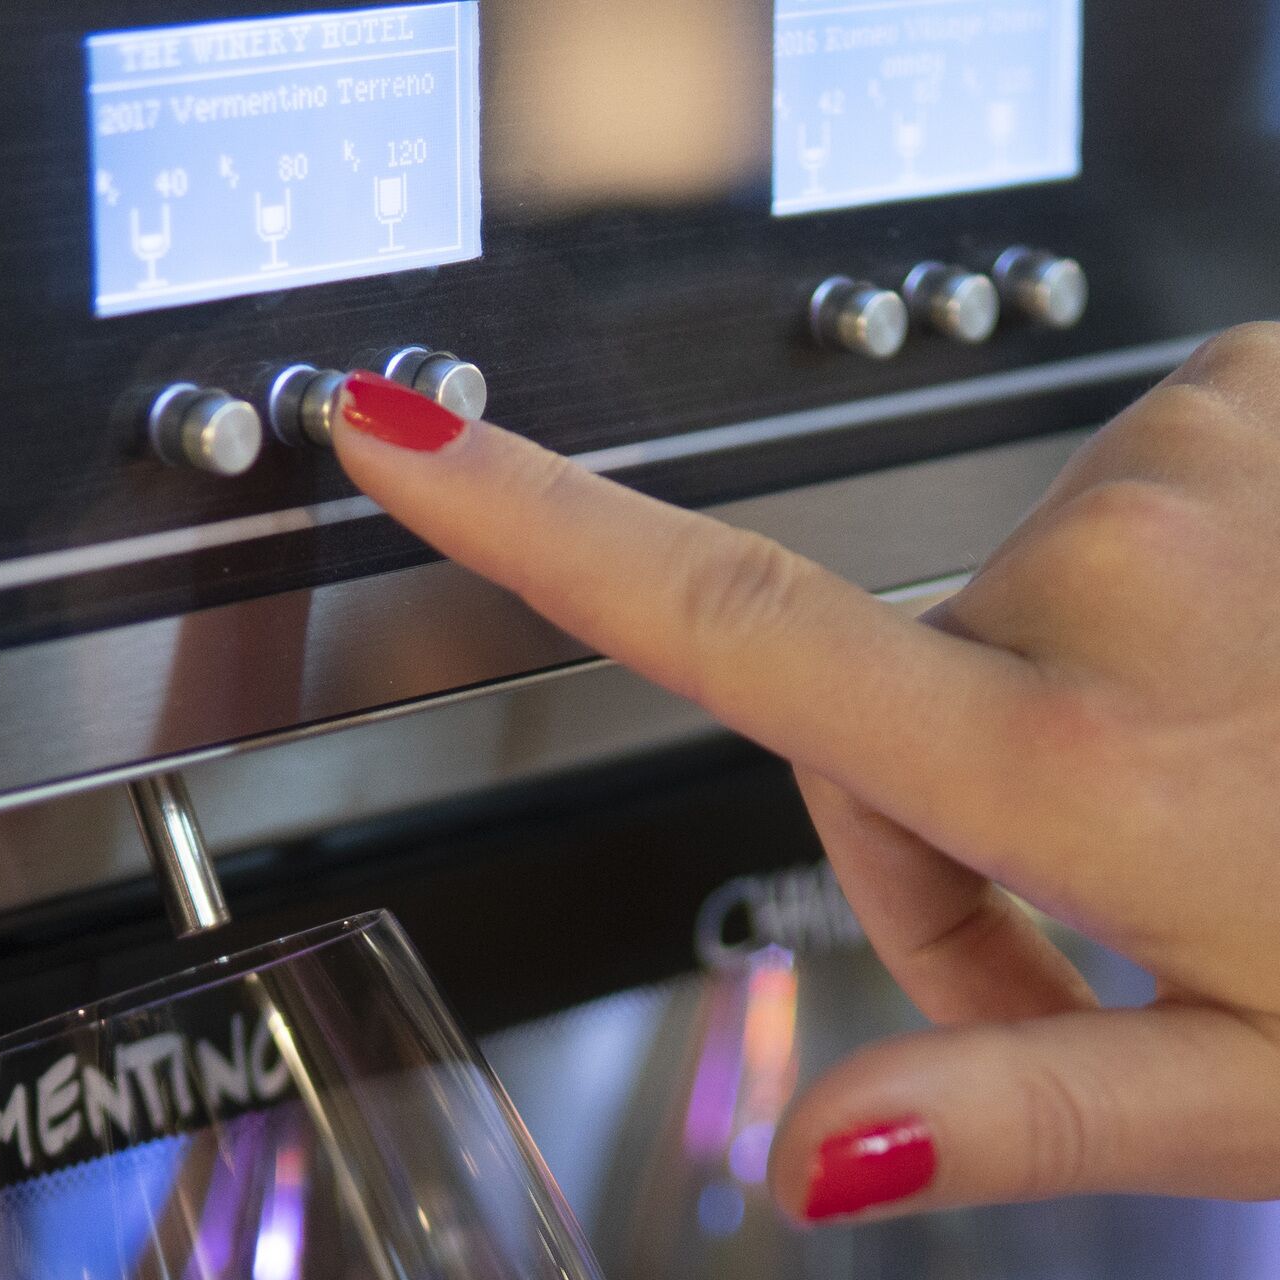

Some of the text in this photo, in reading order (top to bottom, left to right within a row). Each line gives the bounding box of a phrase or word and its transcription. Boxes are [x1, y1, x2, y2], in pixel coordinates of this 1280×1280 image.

[122, 14, 415, 73] THE WINERY HOTEL
[97, 71, 436, 137] 2017 Vermentino Terreno
[278, 152, 309, 183] 80
[387, 137, 428, 168] 120
[154, 167, 189, 199] 40
